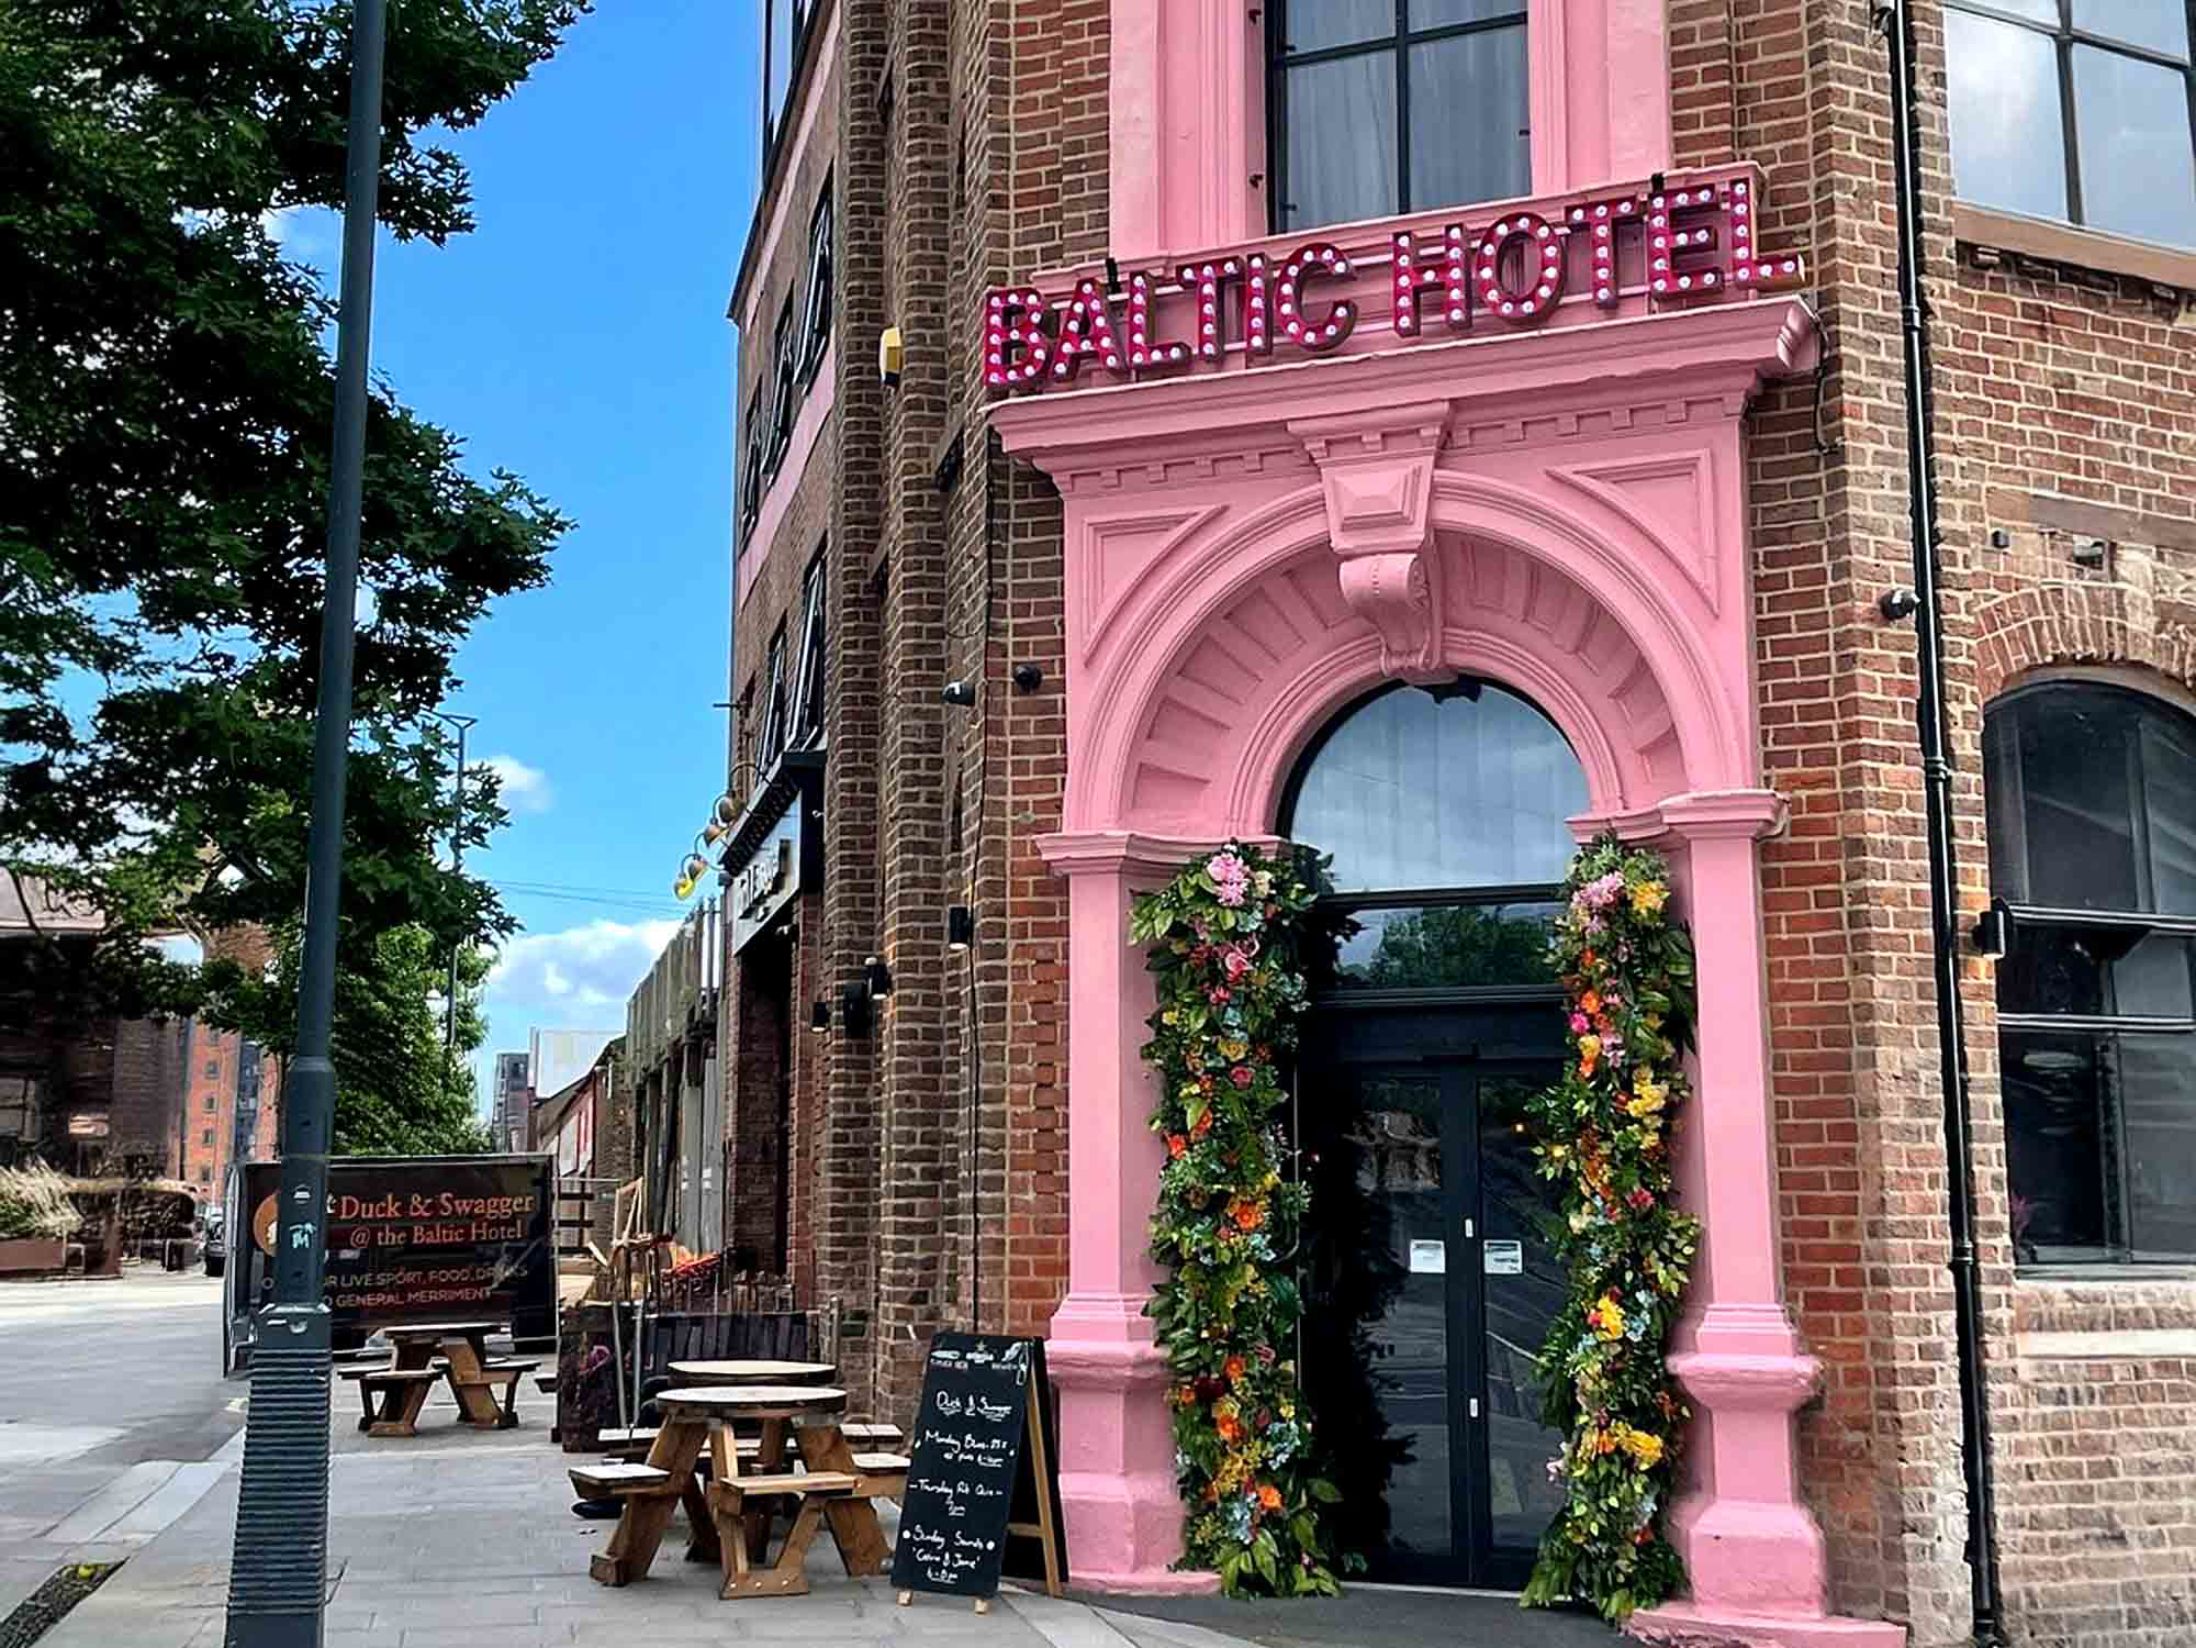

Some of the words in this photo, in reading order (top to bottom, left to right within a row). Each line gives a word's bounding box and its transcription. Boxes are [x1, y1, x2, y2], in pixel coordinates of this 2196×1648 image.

[984, 242, 1358, 390] BALTIC
[1392, 177, 1805, 337] HOTEL
[340, 1192, 400, 1219] Duck
[409, 1193, 433, 1217] &
[439, 1192, 535, 1220] Swagger
[350, 1225, 371, 1248] @
[377, 1224, 407, 1247] the
[412, 1222, 465, 1245] Baltic
[471, 1218, 522, 1241] Hotel
[340, 1273, 375, 1287] LIVE
[336, 1292, 405, 1308] GENERAL
[407, 1286, 493, 1304] MERRIMENT
